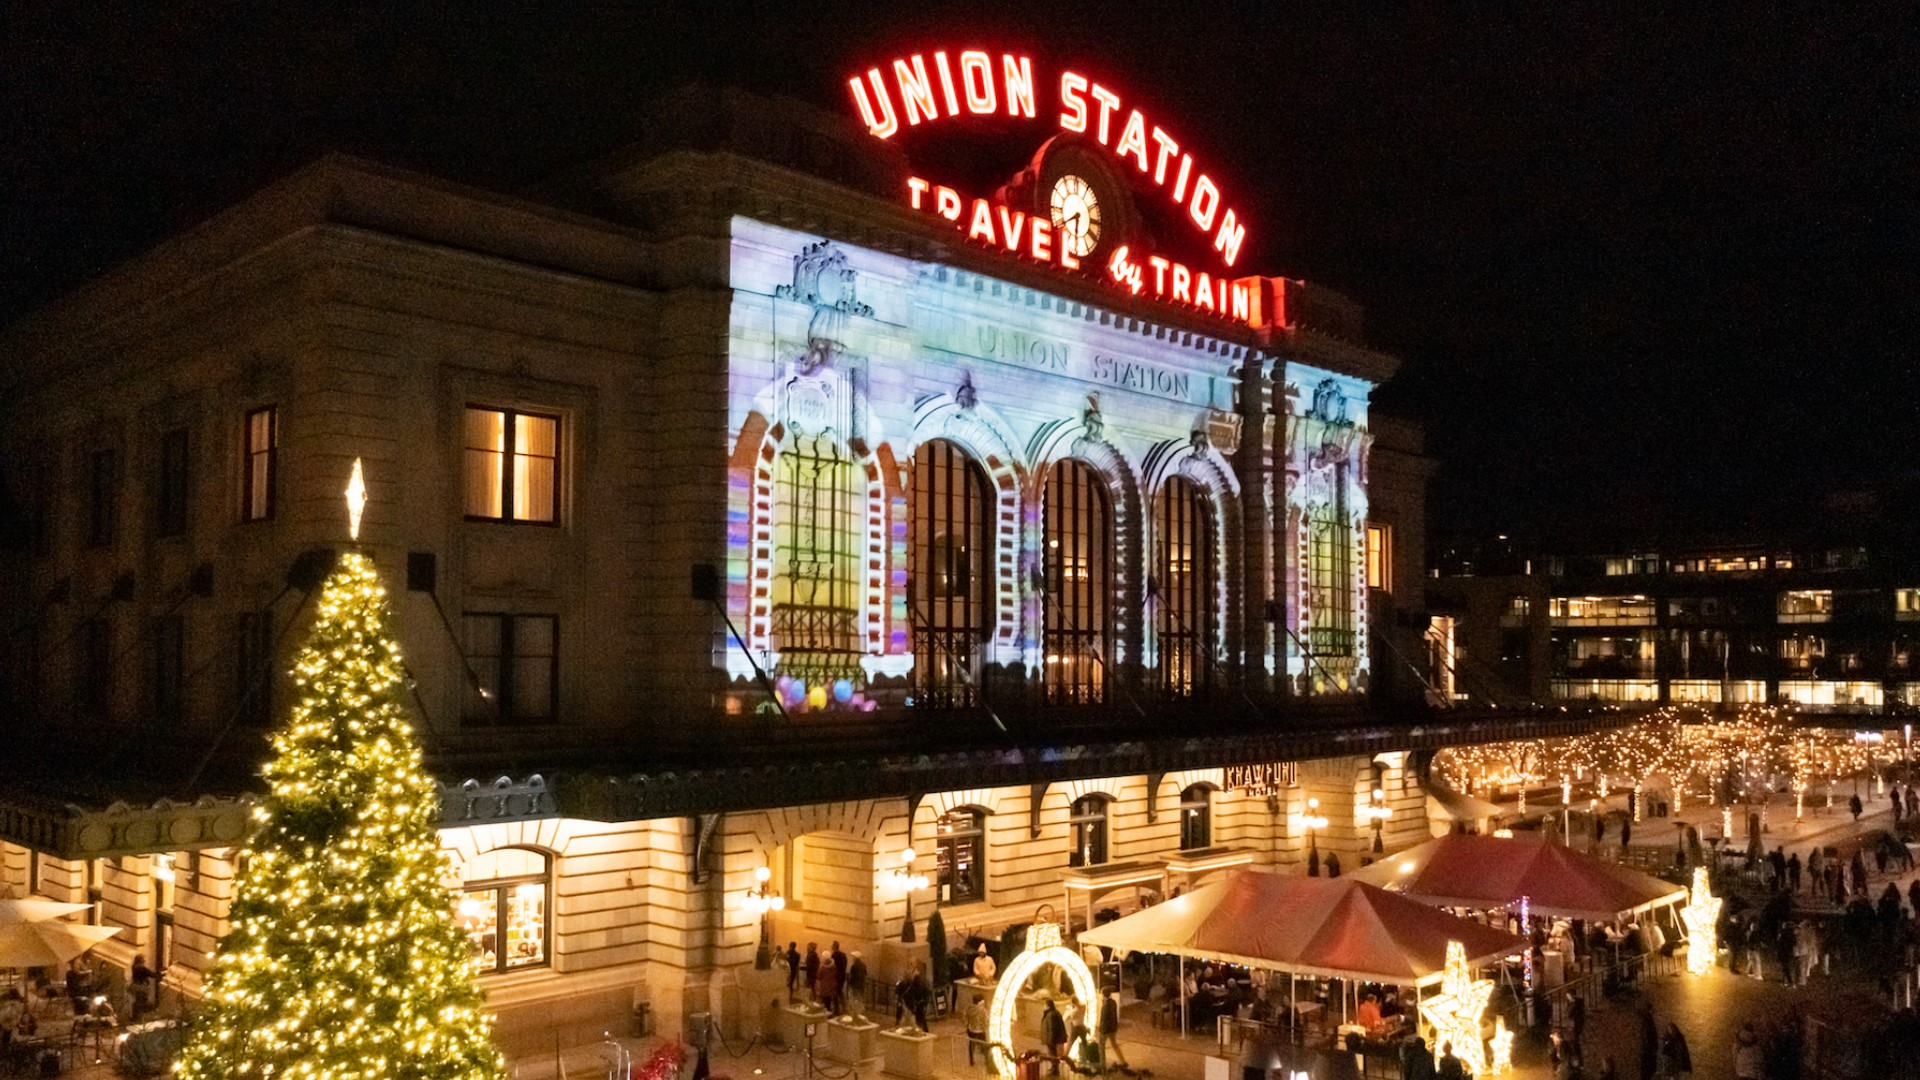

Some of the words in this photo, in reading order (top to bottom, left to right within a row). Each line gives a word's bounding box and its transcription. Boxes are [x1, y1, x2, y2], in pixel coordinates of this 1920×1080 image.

[849, 50, 1036, 140] UNION
[1059, 70, 1246, 268] STATION
[908, 176, 1081, 270] TRAVEL
[1109, 246, 1143, 295] by
[1149, 255, 1249, 321] TRAIN
[977, 325, 1069, 371] UNION
[1093, 354, 1190, 398] STATION
